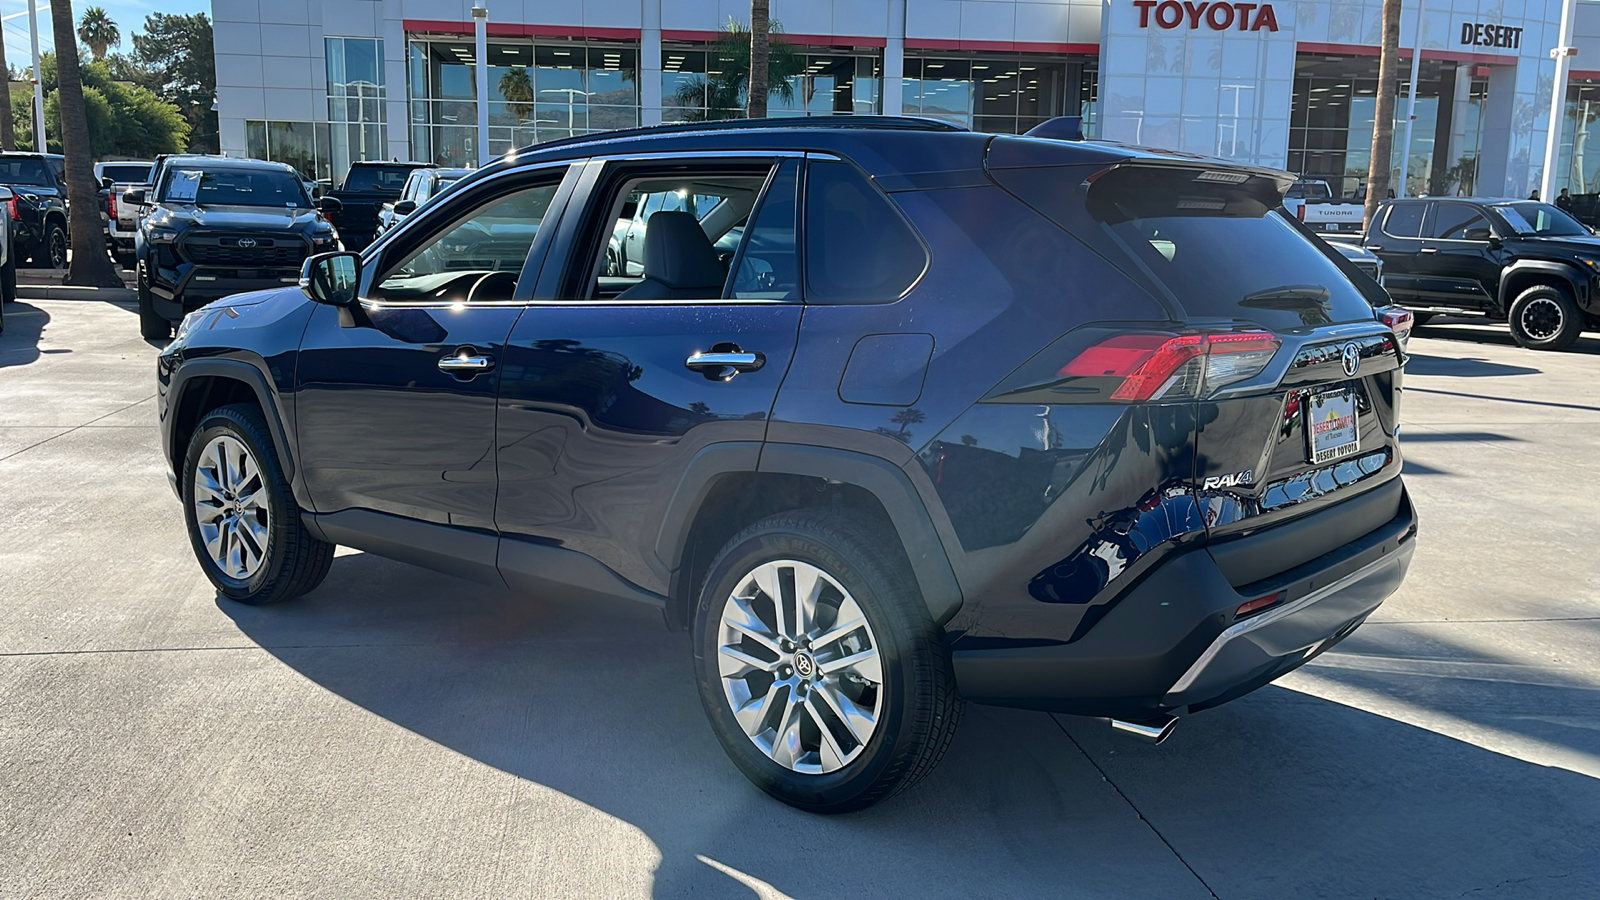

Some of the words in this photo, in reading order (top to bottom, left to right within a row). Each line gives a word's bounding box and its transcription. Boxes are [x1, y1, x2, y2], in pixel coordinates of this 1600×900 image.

[1133, 0, 1279, 32] TOYOTA
[1461, 22, 1523, 49] DESERT
[1313, 420, 1332, 434] DESERT
[1316, 449, 1336, 462] DESERT
[1337, 442, 1358, 456] TOYOTA
[1203, 469, 1252, 491] RAV4
[792, 538, 860, 585] MICHELIN
